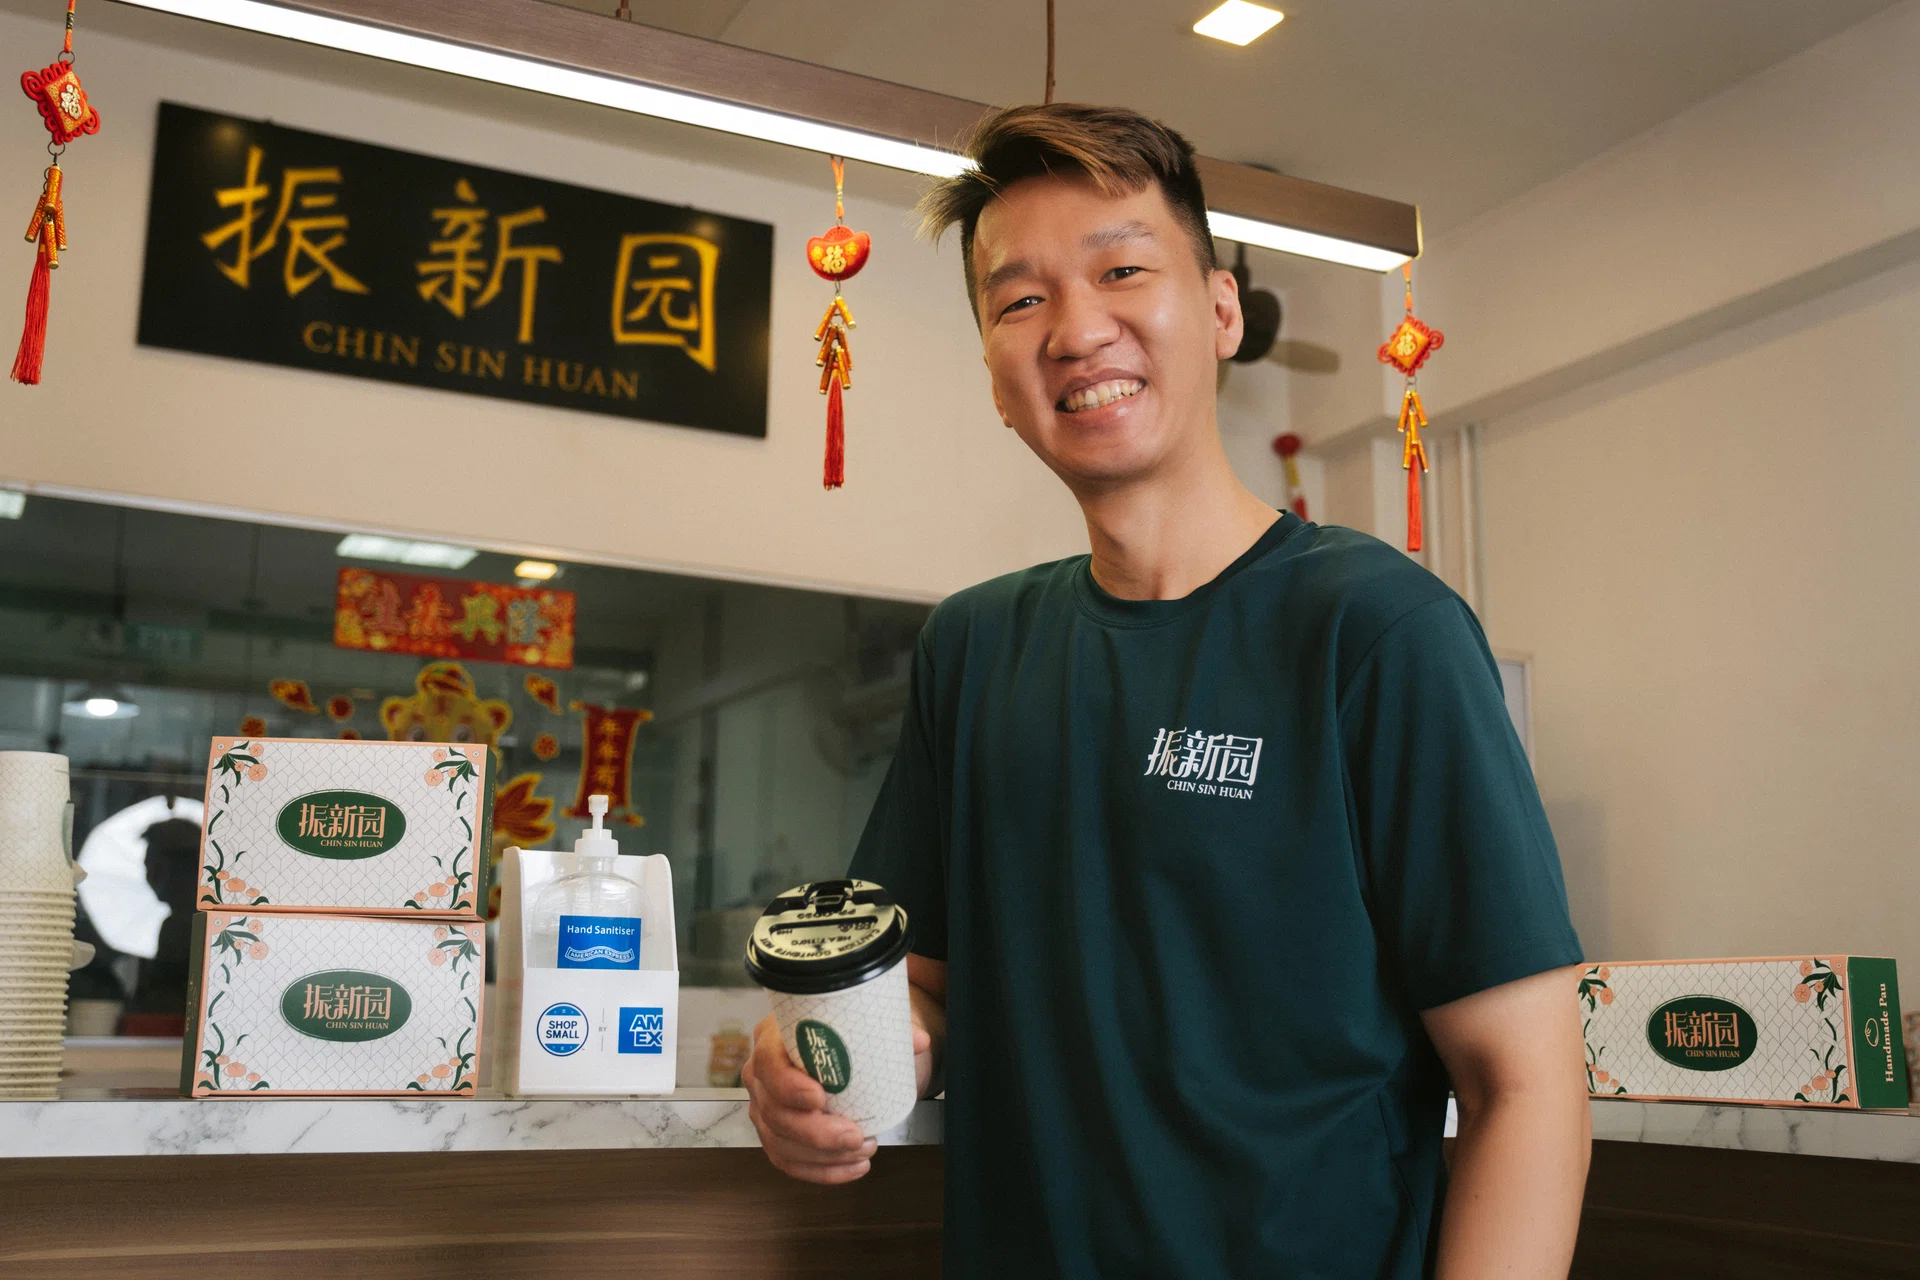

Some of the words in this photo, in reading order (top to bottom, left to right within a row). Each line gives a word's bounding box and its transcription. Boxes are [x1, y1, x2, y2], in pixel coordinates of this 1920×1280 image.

[203, 146, 717, 372] 振新园
[303, 321, 419, 367] CHIN
[434, 341, 507, 379] SIN
[523, 355, 640, 400] HUAN
[1144, 726, 1263, 786] 振新园
[1167, 780, 1196, 792] CHIN
[1197, 783, 1217, 795] SIN
[1219, 787, 1253, 800] HUAN
[299, 803, 386, 839] 振新园
[320, 839, 342, 847] CHIN
[344, 840, 358, 848] SIN
[359, 840, 383, 848] HUAN
[567, 924, 592, 934] Hand
[594, 925, 635, 936] Sanitiser
[570, 949, 603, 959] AMERICAN
[604, 949, 630, 960] EXPRESS
[303, 983, 392, 1020] 振新园
[1879, 983, 1888, 1007] Pau
[325, 1021, 348, 1029] CHIN
[365, 1022, 389, 1030] HUAN
[545, 1029, 580, 1039] SMALL
[548, 1020, 578, 1030] SHOP
[1664, 1010, 1739, 1048] 振新园
[1719, 1050, 1740, 1058] HUAN
[1880, 1010, 1894, 1082] Handmade
